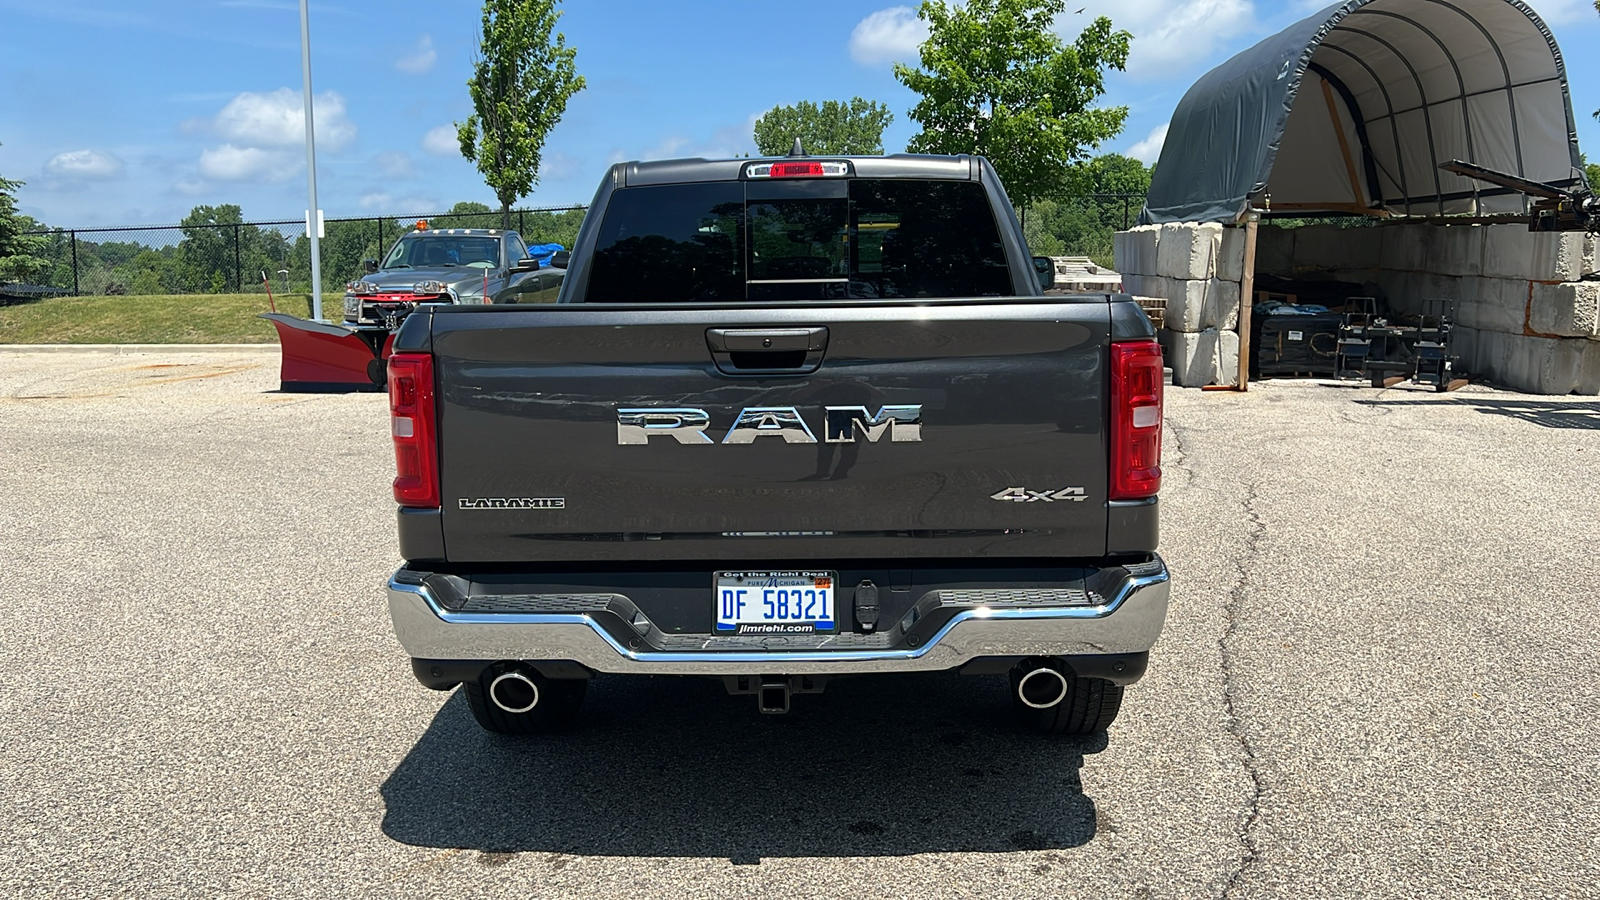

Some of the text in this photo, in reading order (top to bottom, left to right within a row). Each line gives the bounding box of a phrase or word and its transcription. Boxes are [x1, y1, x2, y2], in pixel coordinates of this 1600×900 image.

[617, 404, 923, 445] RAM
[990, 486, 1089, 503] 4x4
[458, 497, 566, 510] LARAMIE
[761, 577, 805, 590] MICHIGAN
[722, 590, 830, 619] DF 58321
[738, 624, 813, 634] jimriehl.com
